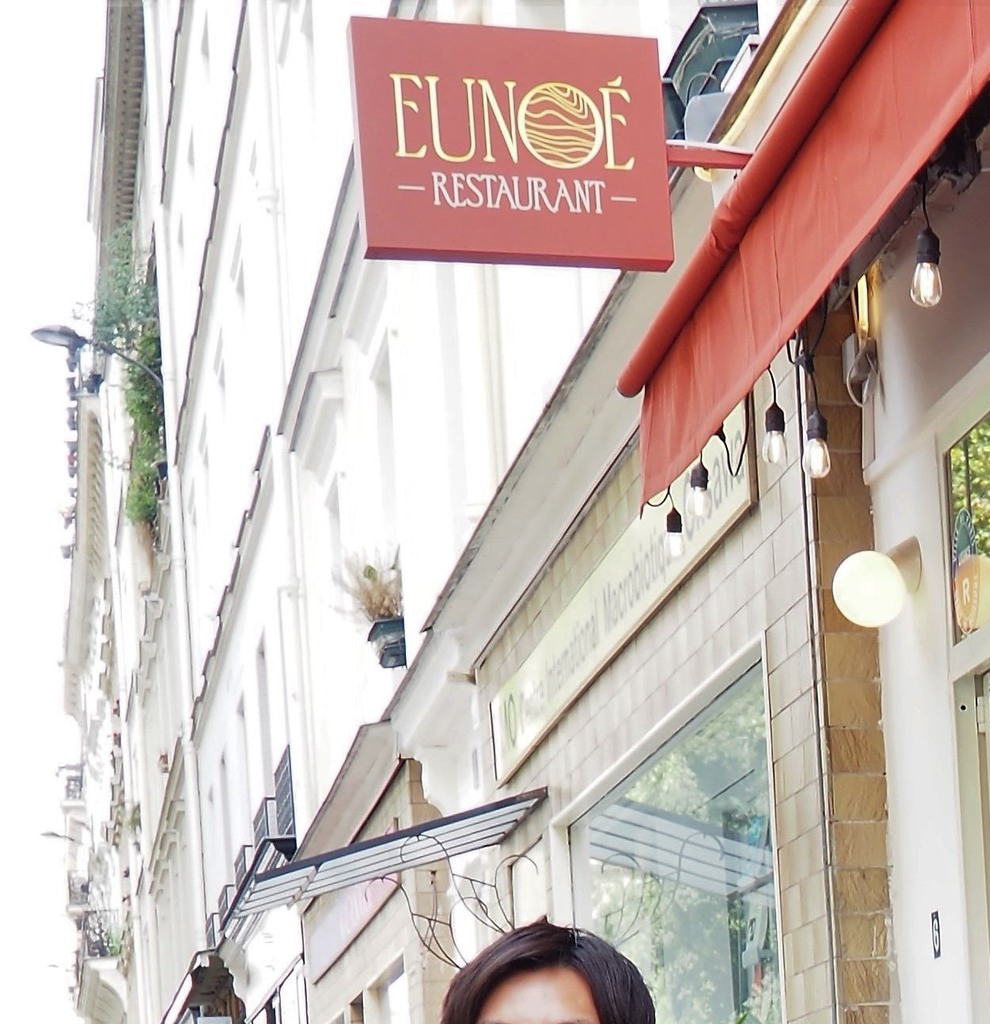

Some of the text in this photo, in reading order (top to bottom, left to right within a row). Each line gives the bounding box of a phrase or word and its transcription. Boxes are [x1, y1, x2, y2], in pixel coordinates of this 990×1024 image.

[389, 73, 636, 171] EUNOÉ
[431, 171, 606, 214] RESTAURANT
[962, 577, 971, 605] R
